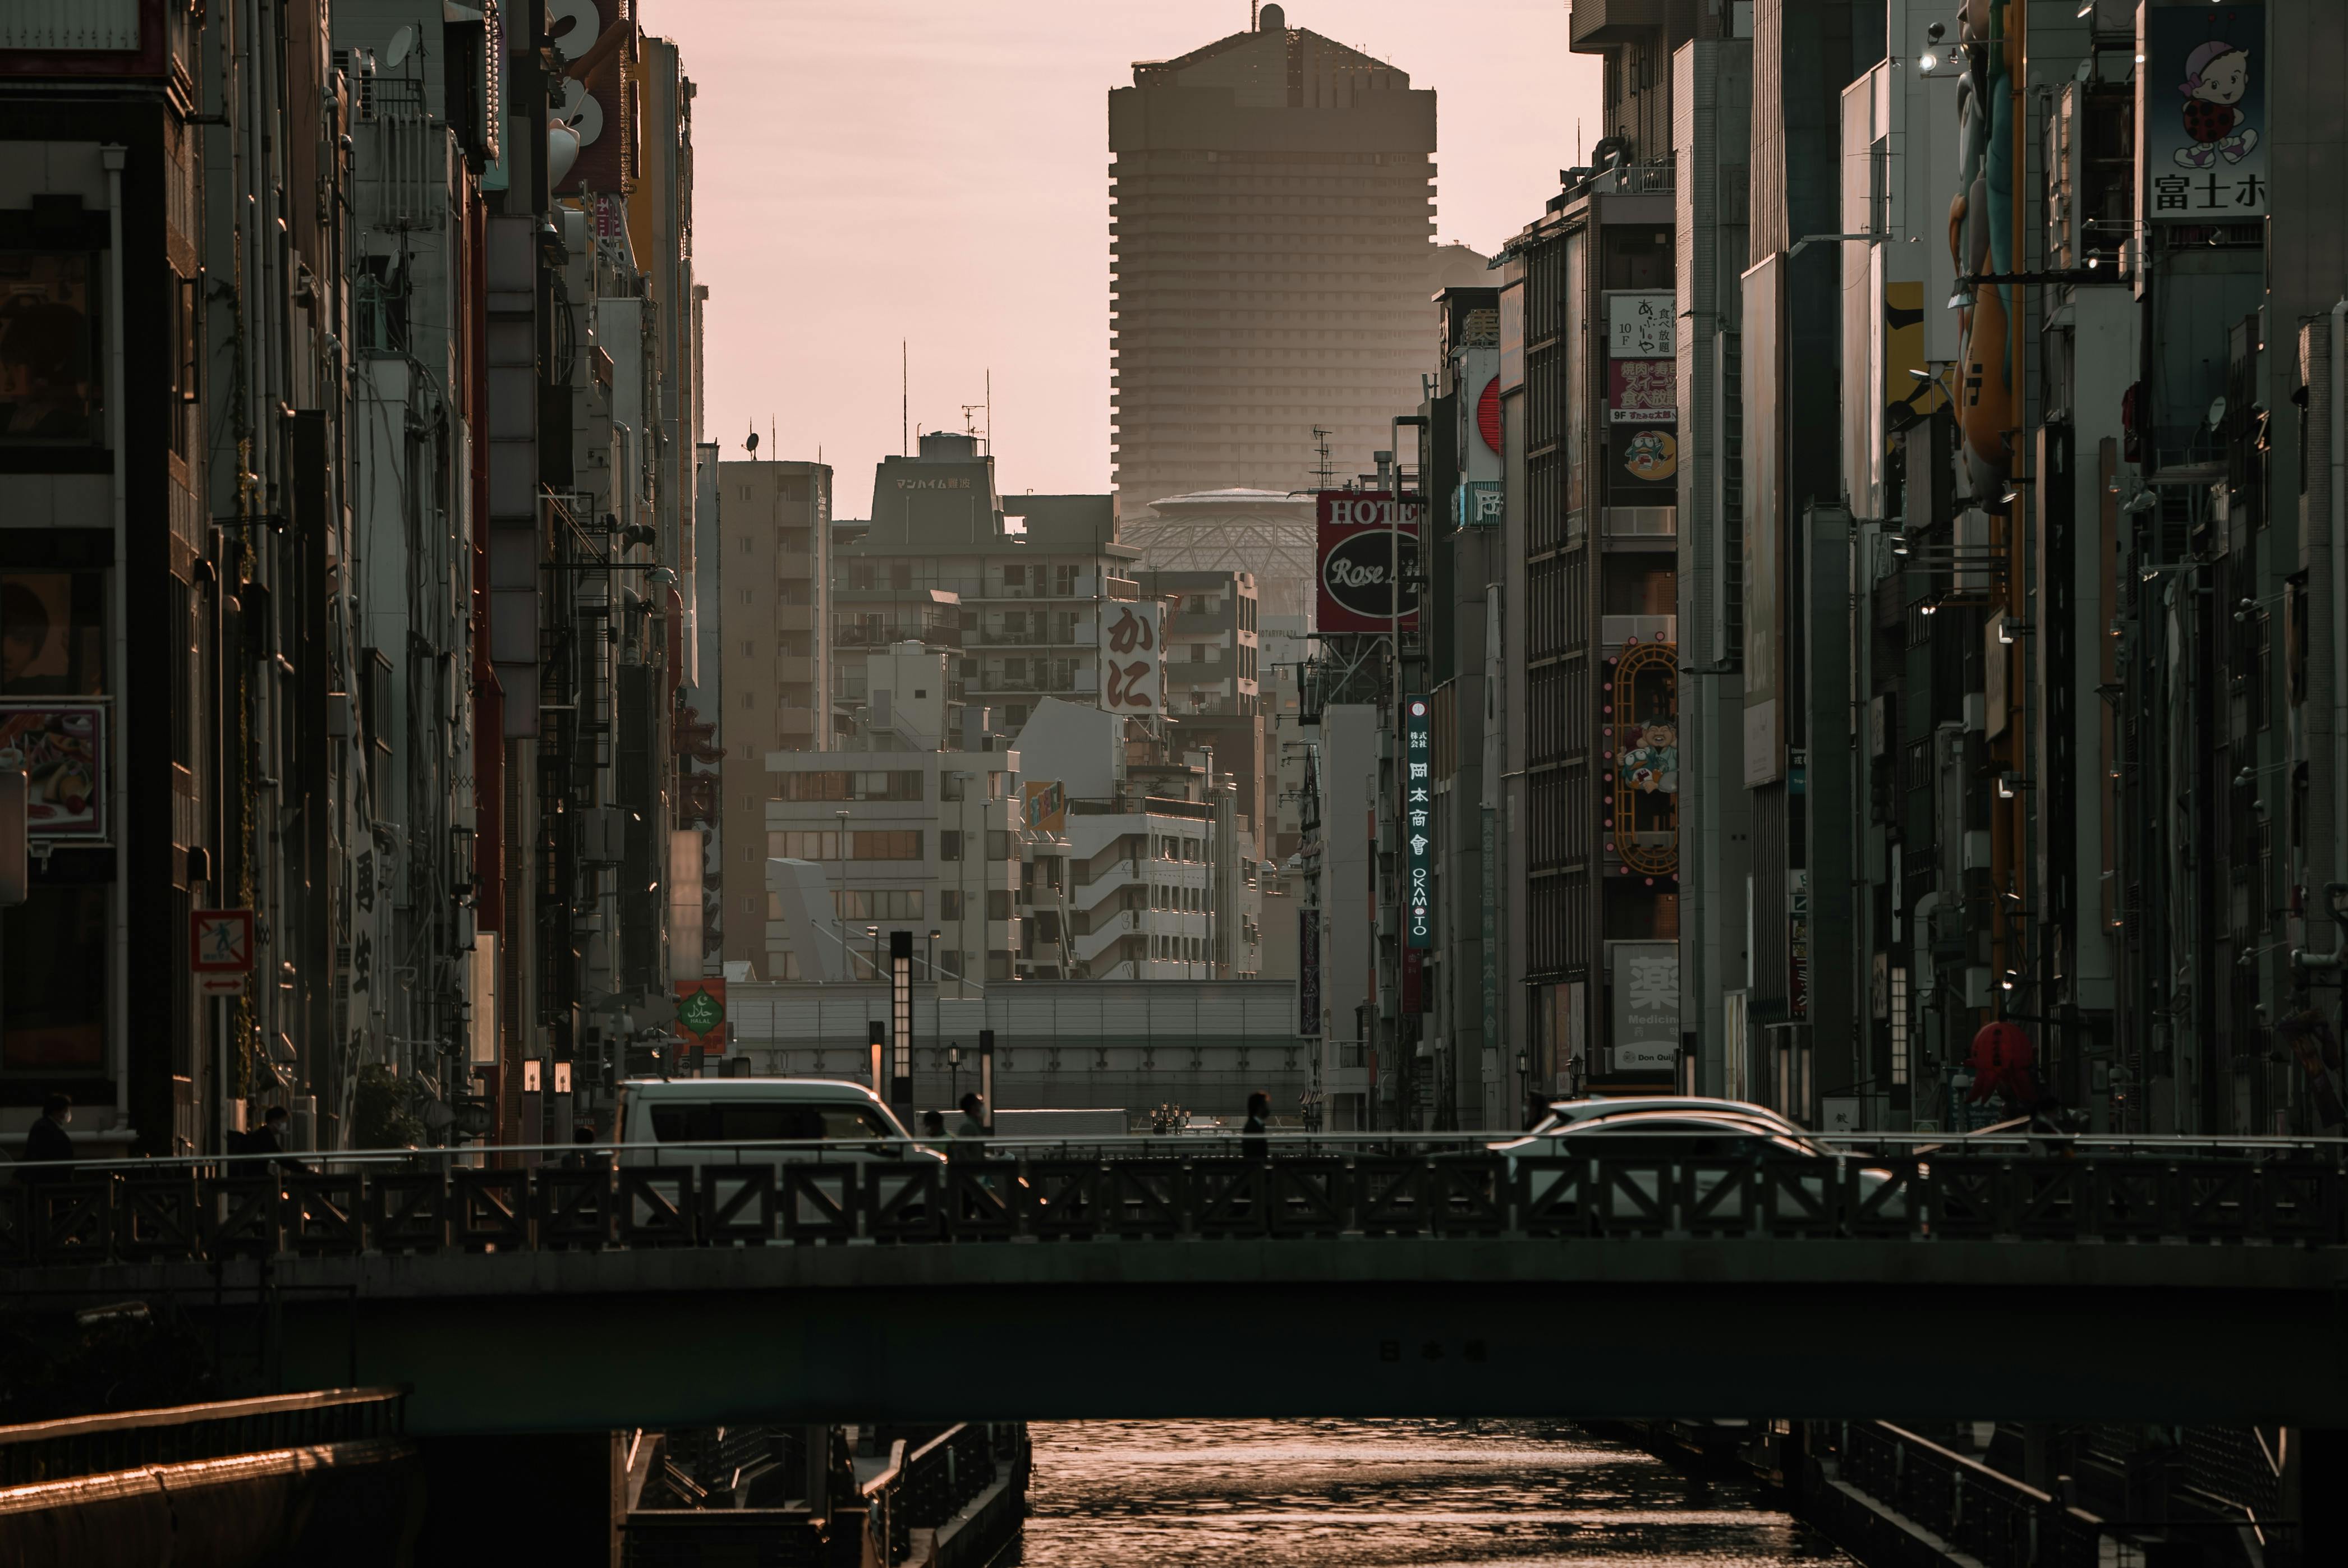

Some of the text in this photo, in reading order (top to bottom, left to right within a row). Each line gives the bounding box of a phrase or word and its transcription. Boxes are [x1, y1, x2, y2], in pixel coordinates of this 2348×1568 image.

[1619, 324, 1632, 333] 10
[1638, 299, 1657, 353] あぶりや
[1658, 308, 1670, 353] 食べ放題
[1622, 336, 1629, 345] F
[1614, 411, 1626, 420] 9F
[897, 477, 970, 489] マンハイム難波
[1330, 557, 1384, 587] Rose
[1108, 607, 1153, 707] かに
[1410, 732, 1427, 748] 株式会社
[1412, 868, 1428, 935] OKAMOTO
[1629, 957, 1679, 1010] 薬
[687, 1004, 713, 1018] حلال
[1628, 1015, 1679, 1024] Medicin
